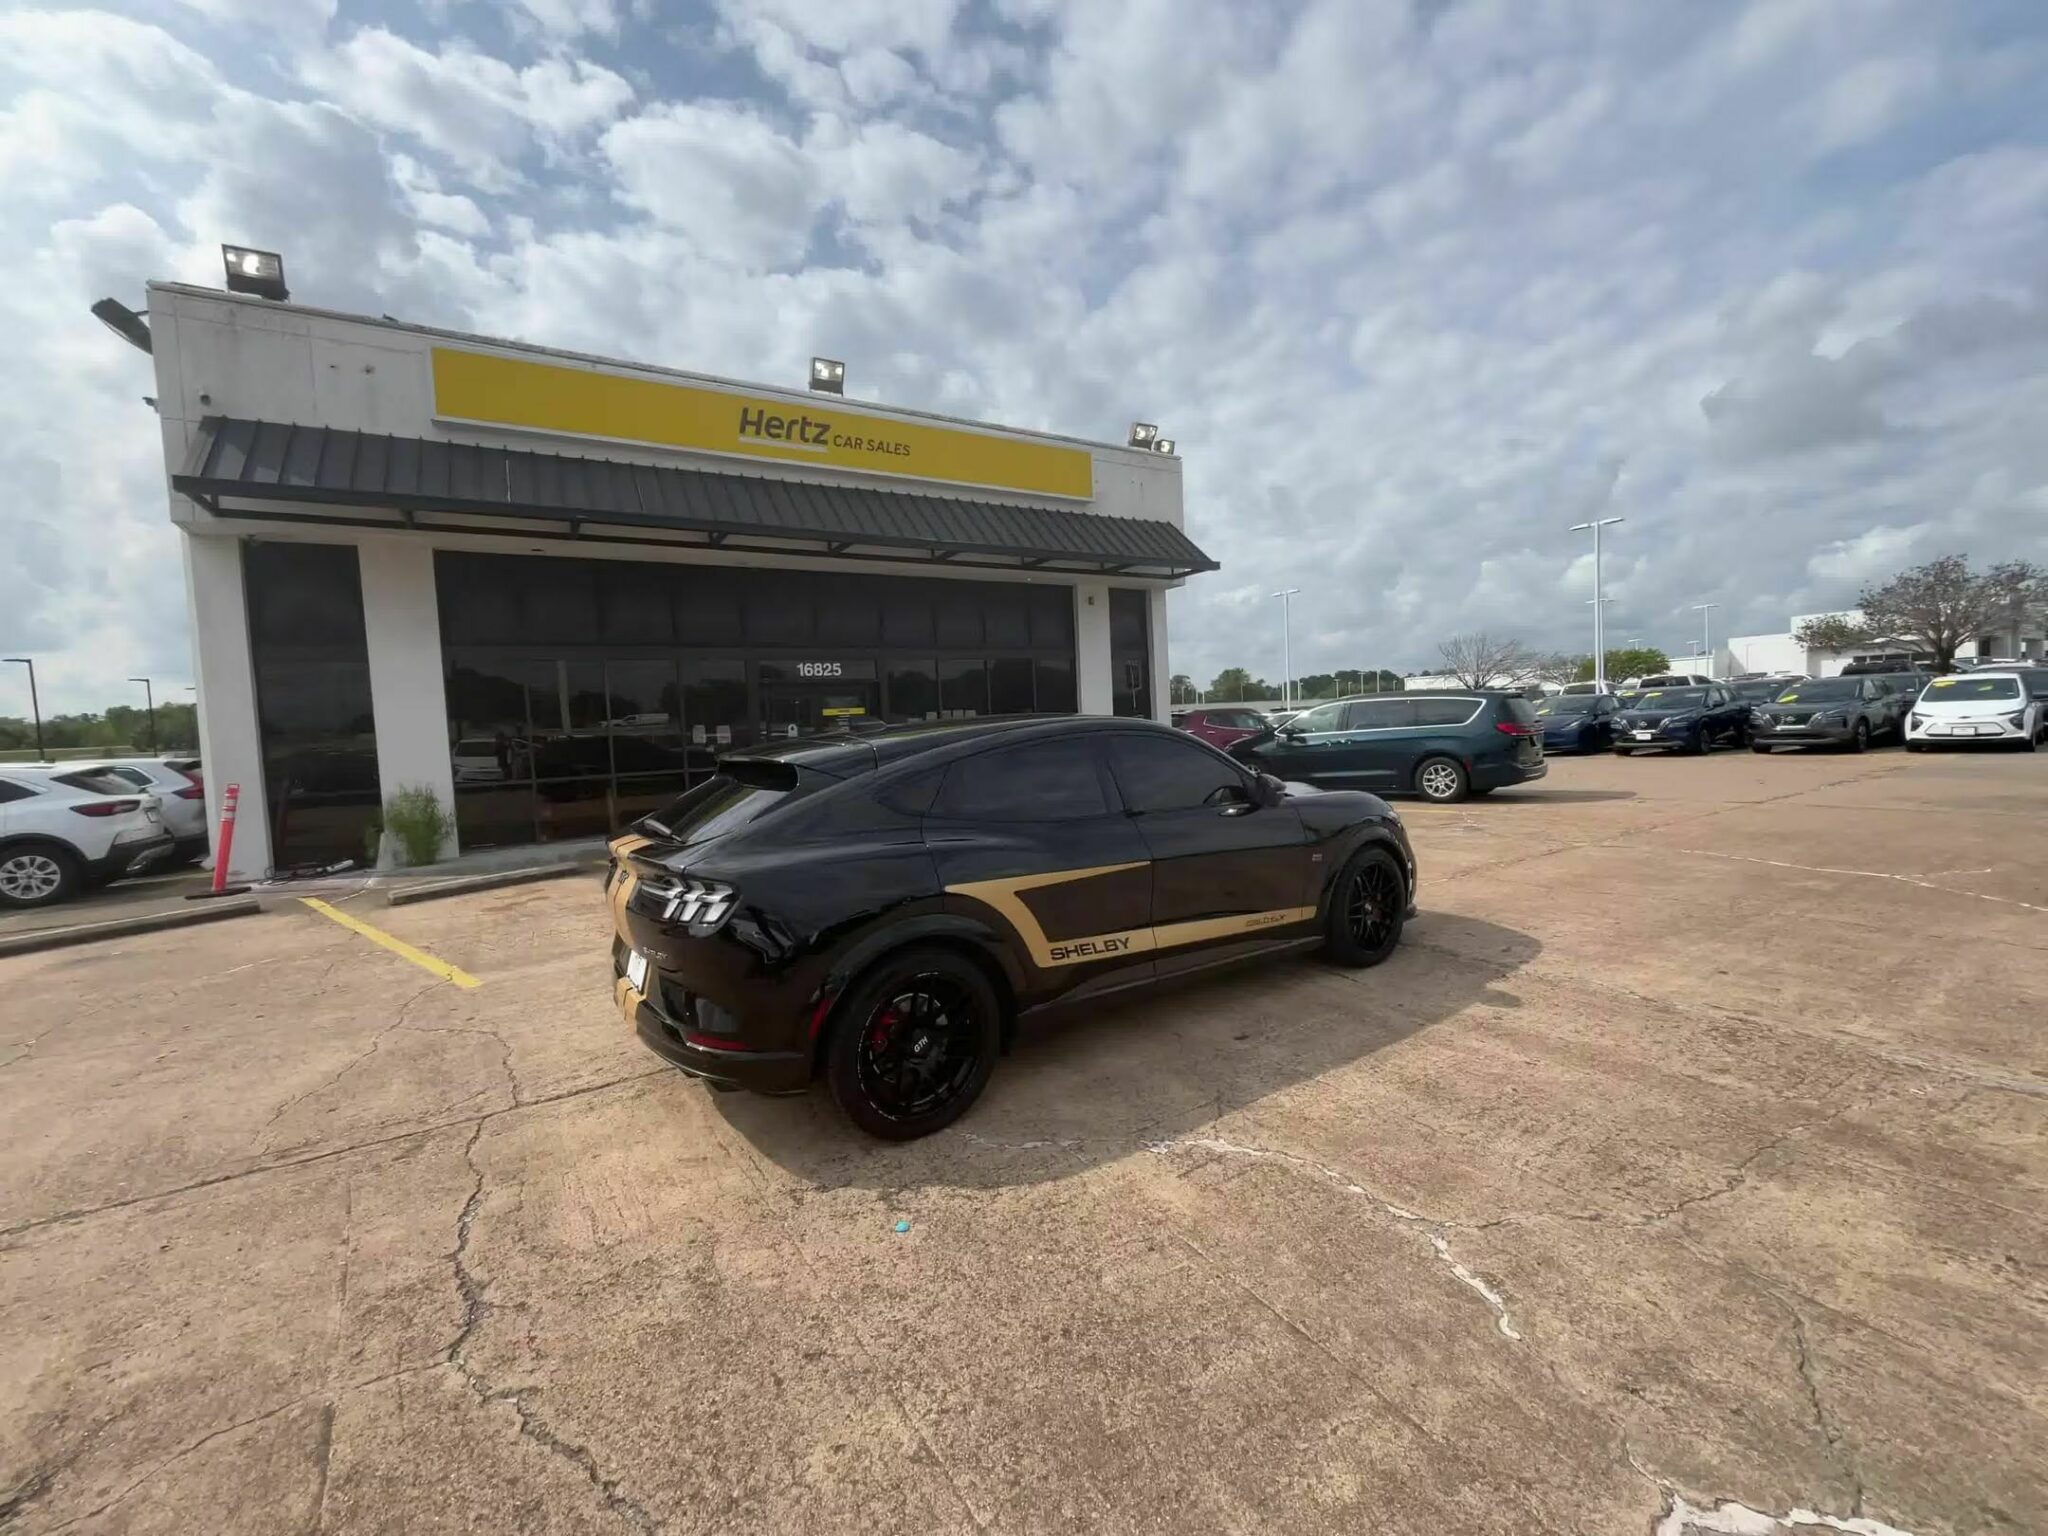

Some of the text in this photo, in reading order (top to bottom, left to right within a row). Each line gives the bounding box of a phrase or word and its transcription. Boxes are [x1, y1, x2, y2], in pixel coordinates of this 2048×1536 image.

[738, 407, 911, 456] Hertz CAR SALES
[796, 662, 842, 677] 16825
[1050, 937, 1130, 961] SHELBY
